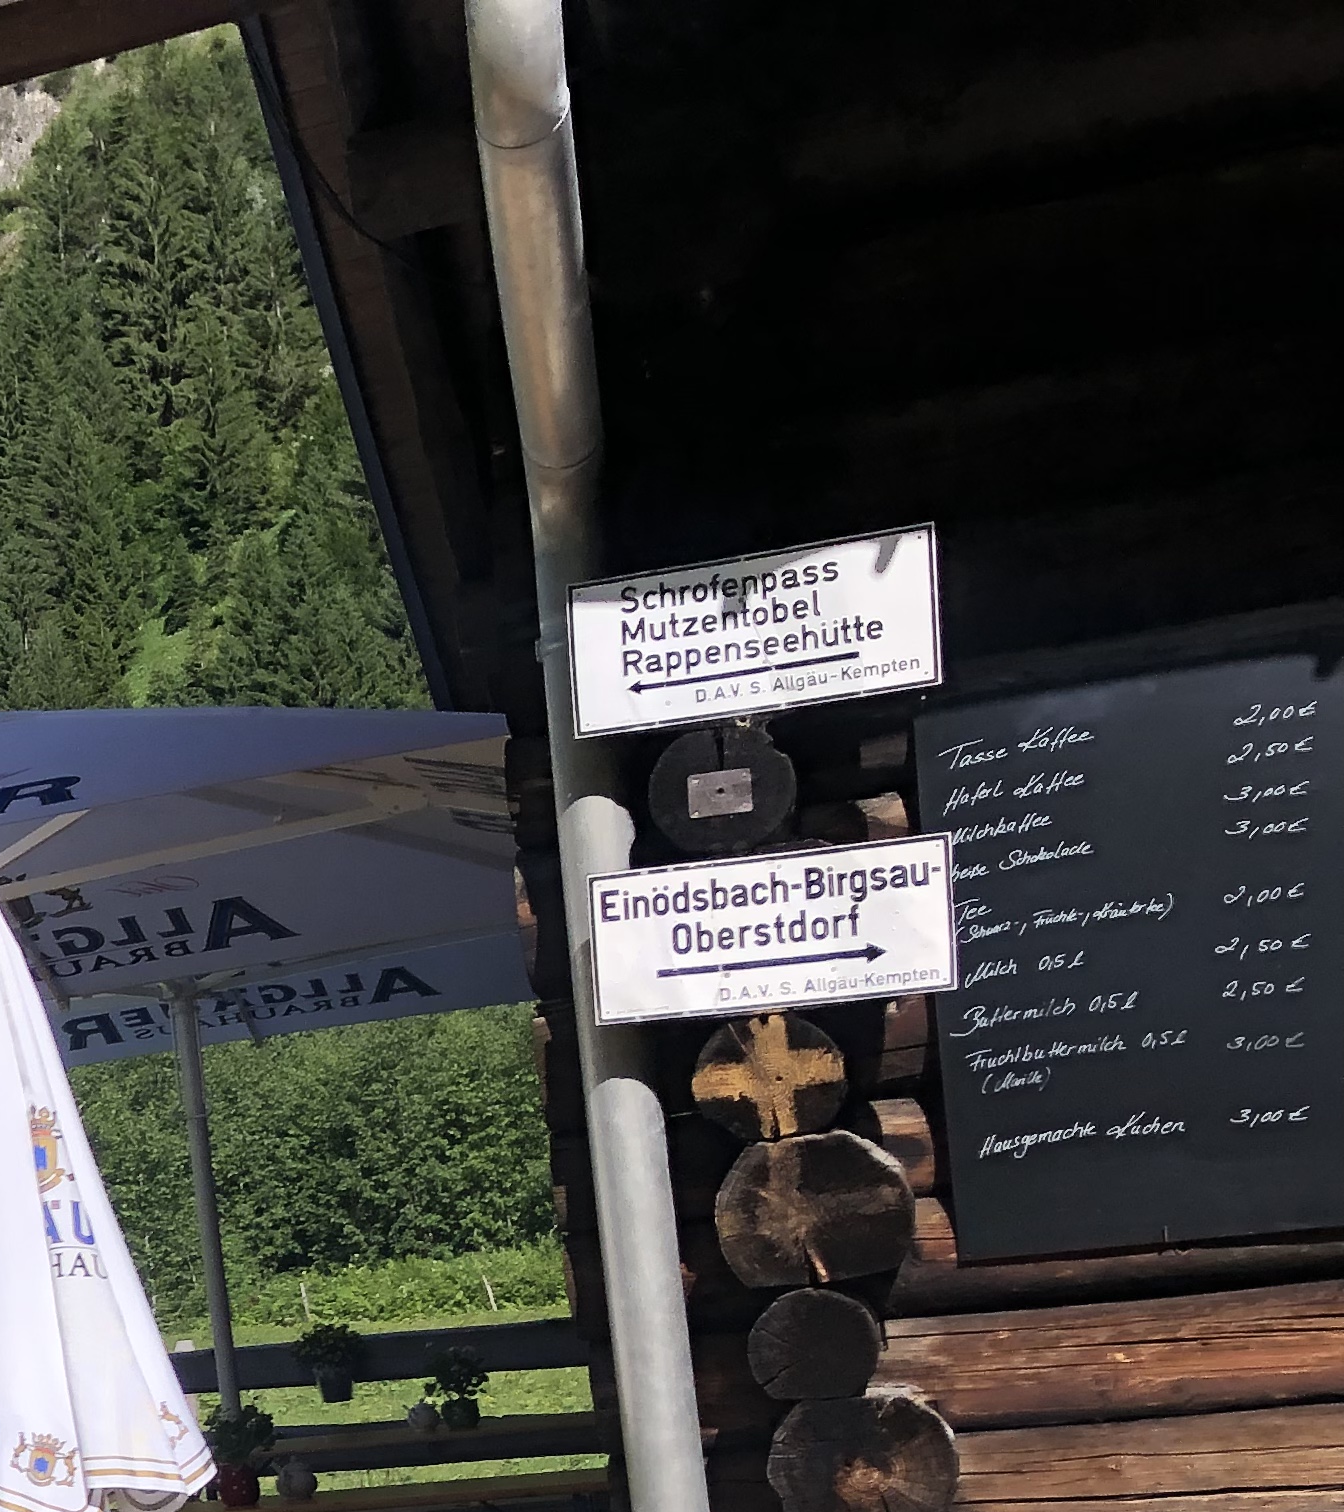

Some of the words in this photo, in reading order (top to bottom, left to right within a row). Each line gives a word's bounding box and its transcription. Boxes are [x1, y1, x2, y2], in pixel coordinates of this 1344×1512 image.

[620, 560, 840, 614] Schrofenpass
[621, 590, 822, 646] Mutzentobel
[622, 615, 885, 678] Rappenseehütte
[771, 656, 921, 693] Allgäu-Kempten
[938, 738, 1009, 771] Tasse
[1018, 726, 1096, 753] Kaffee
[943, 779, 1005, 817] Haferl
[1013, 770, 1086, 799] Kaffee
[998, 840, 1095, 870] Schokolade
[600, 861, 942, 923] Einödsbach-Birgsau-
[954, 897, 992, 925] Tee
[673, 903, 861, 955] Oberstdorf
[804, 967, 941, 993] Allgäu-Kempten
[964, 958, 1018, 989] Milch
[950, 998, 1076, 1037] Buttermilch
[979, 1121, 1097, 1159] Hausgemachte
[1106, 1112, 1186, 1140] Kuchen
